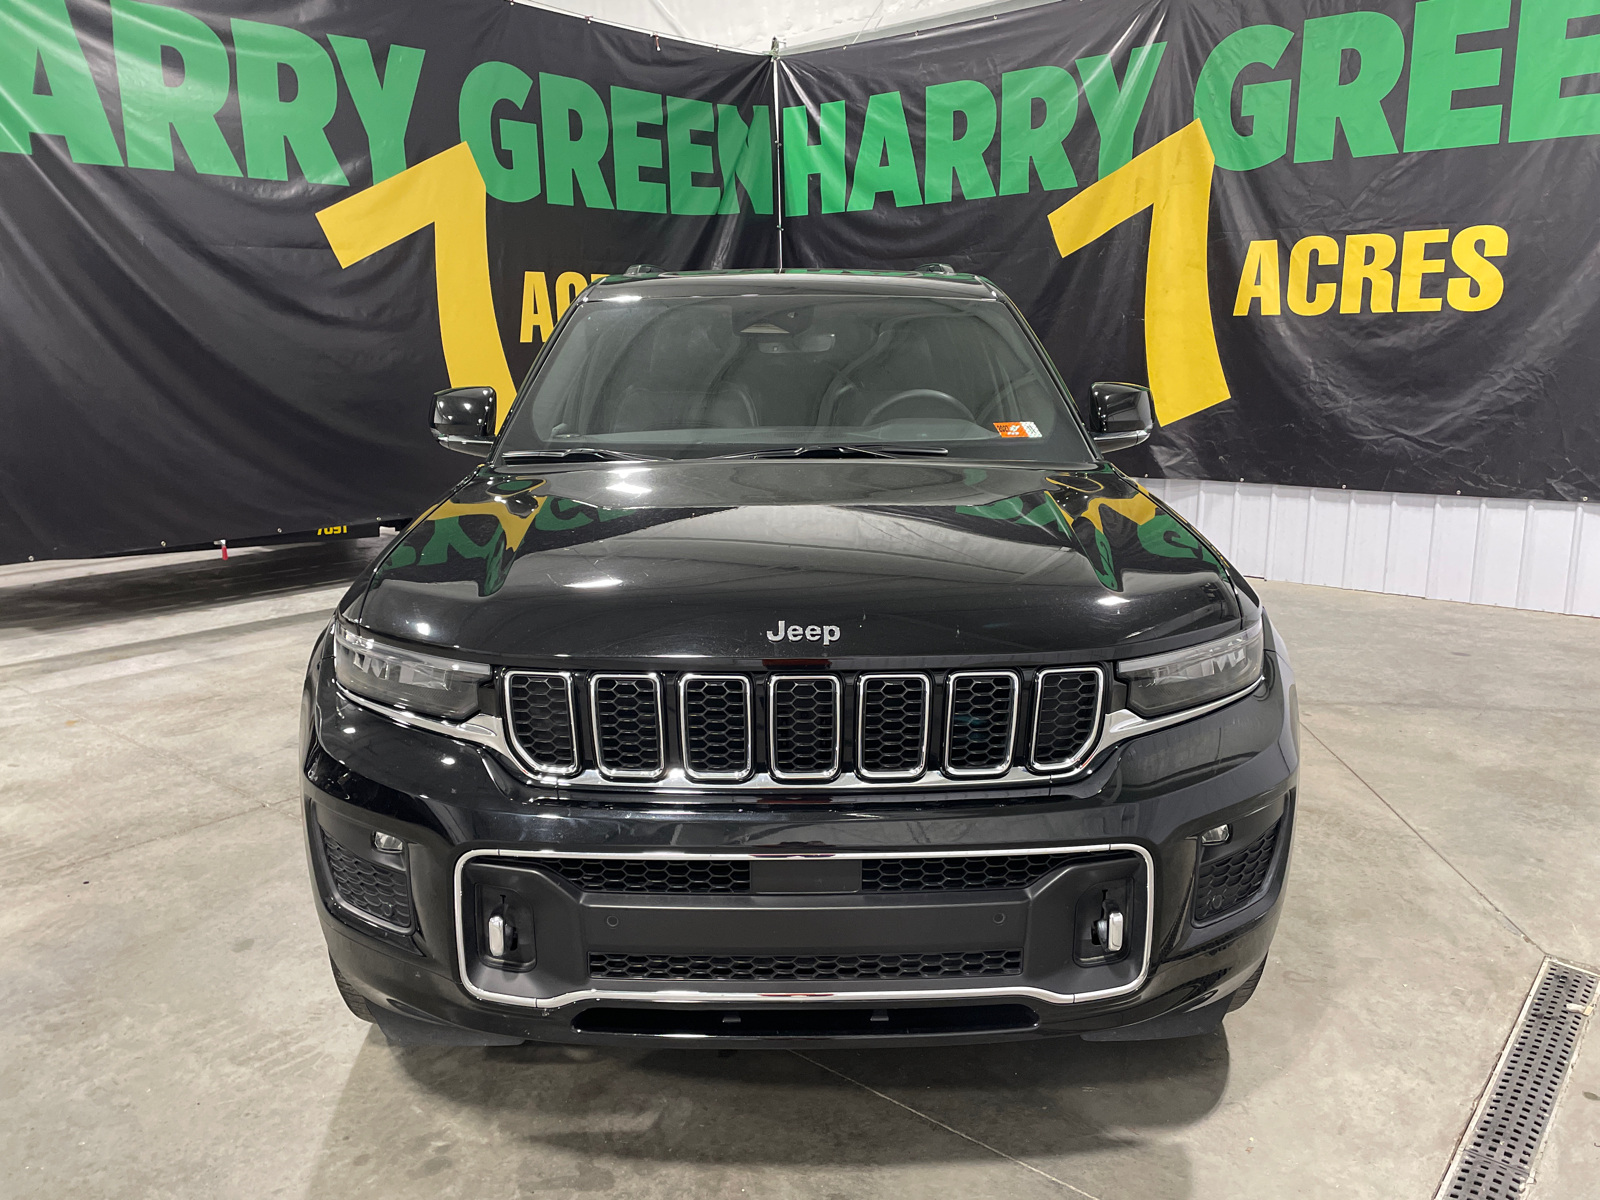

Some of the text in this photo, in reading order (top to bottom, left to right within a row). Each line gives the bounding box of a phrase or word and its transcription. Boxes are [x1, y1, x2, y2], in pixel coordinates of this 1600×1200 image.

[458, 61, 774, 216] GREEN
[782, 42, 1168, 218] HARRY
[315, 140, 518, 436] 7
[1047, 117, 1508, 427] 7 ACRES
[766, 620, 841, 645] Jeep
